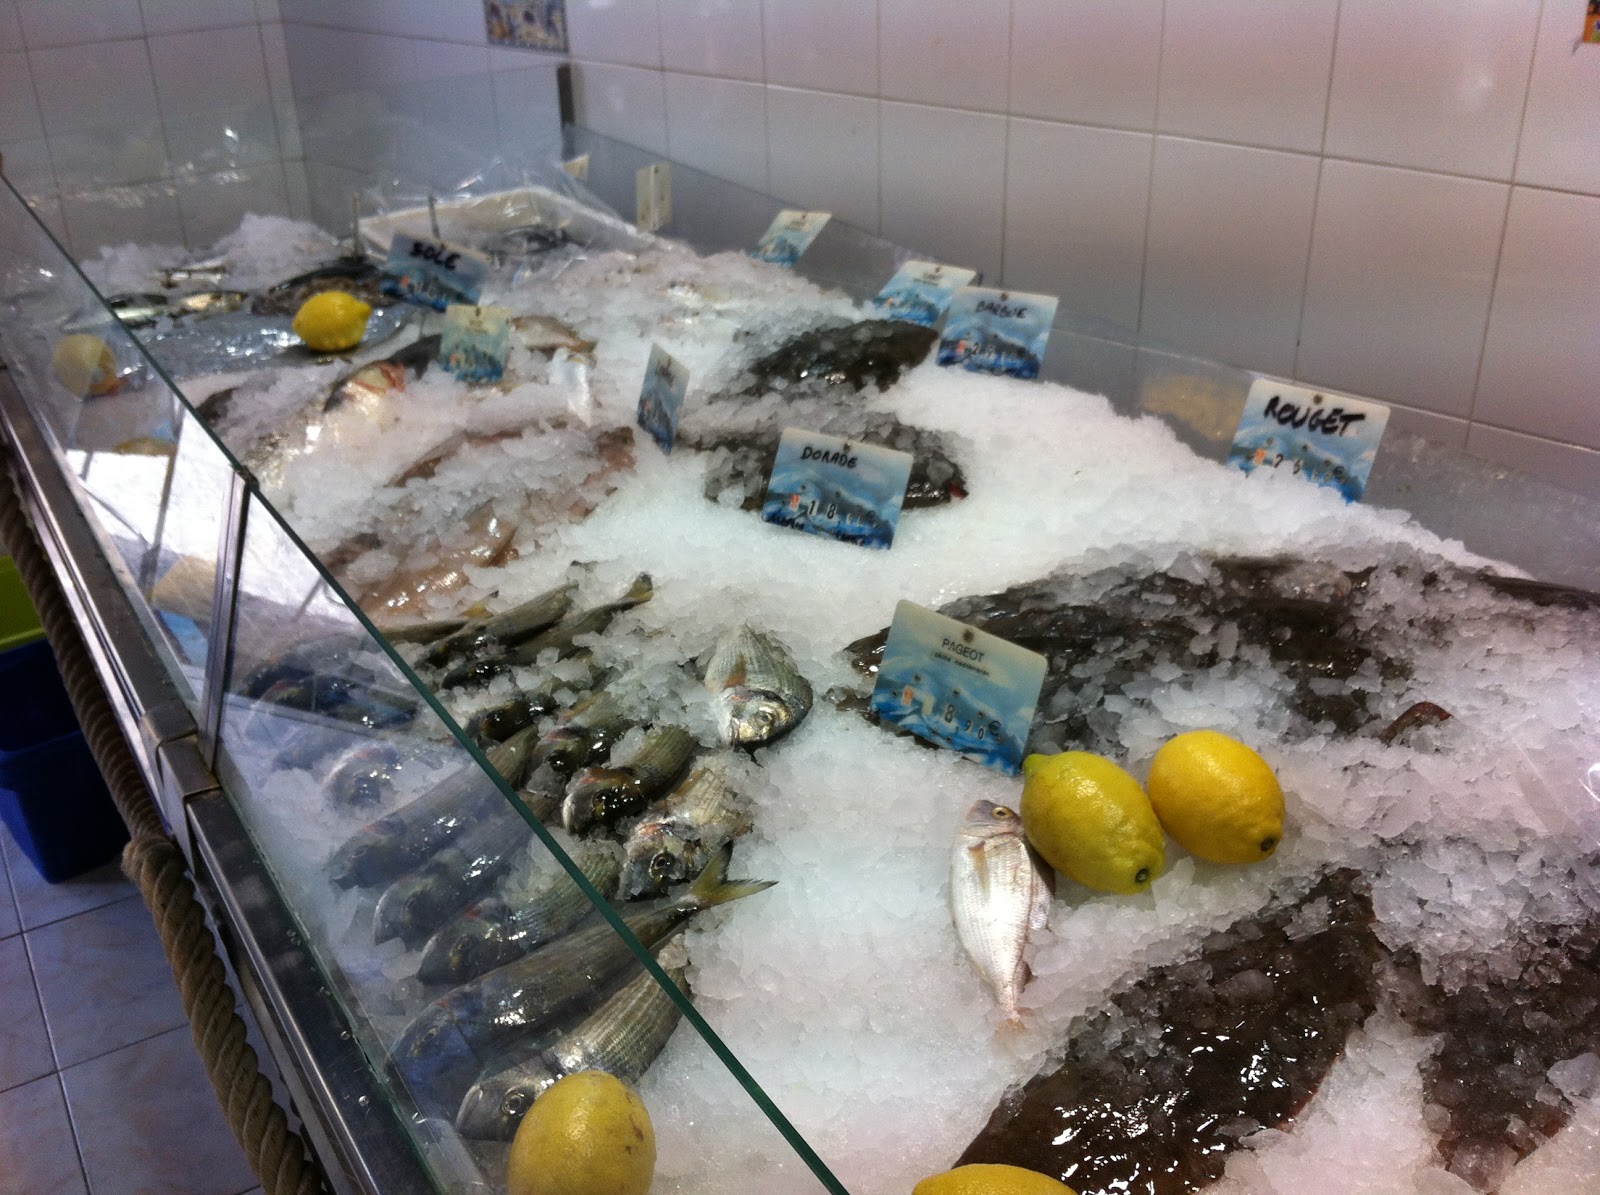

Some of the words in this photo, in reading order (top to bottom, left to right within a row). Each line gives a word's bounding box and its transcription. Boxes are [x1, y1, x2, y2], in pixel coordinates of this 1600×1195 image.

[410, 241, 461, 271] SOLE
[1263, 395, 1366, 437] ROUGET
[801, 446, 859, 468] DORADE
[941, 638, 985, 662] PAGEOT
